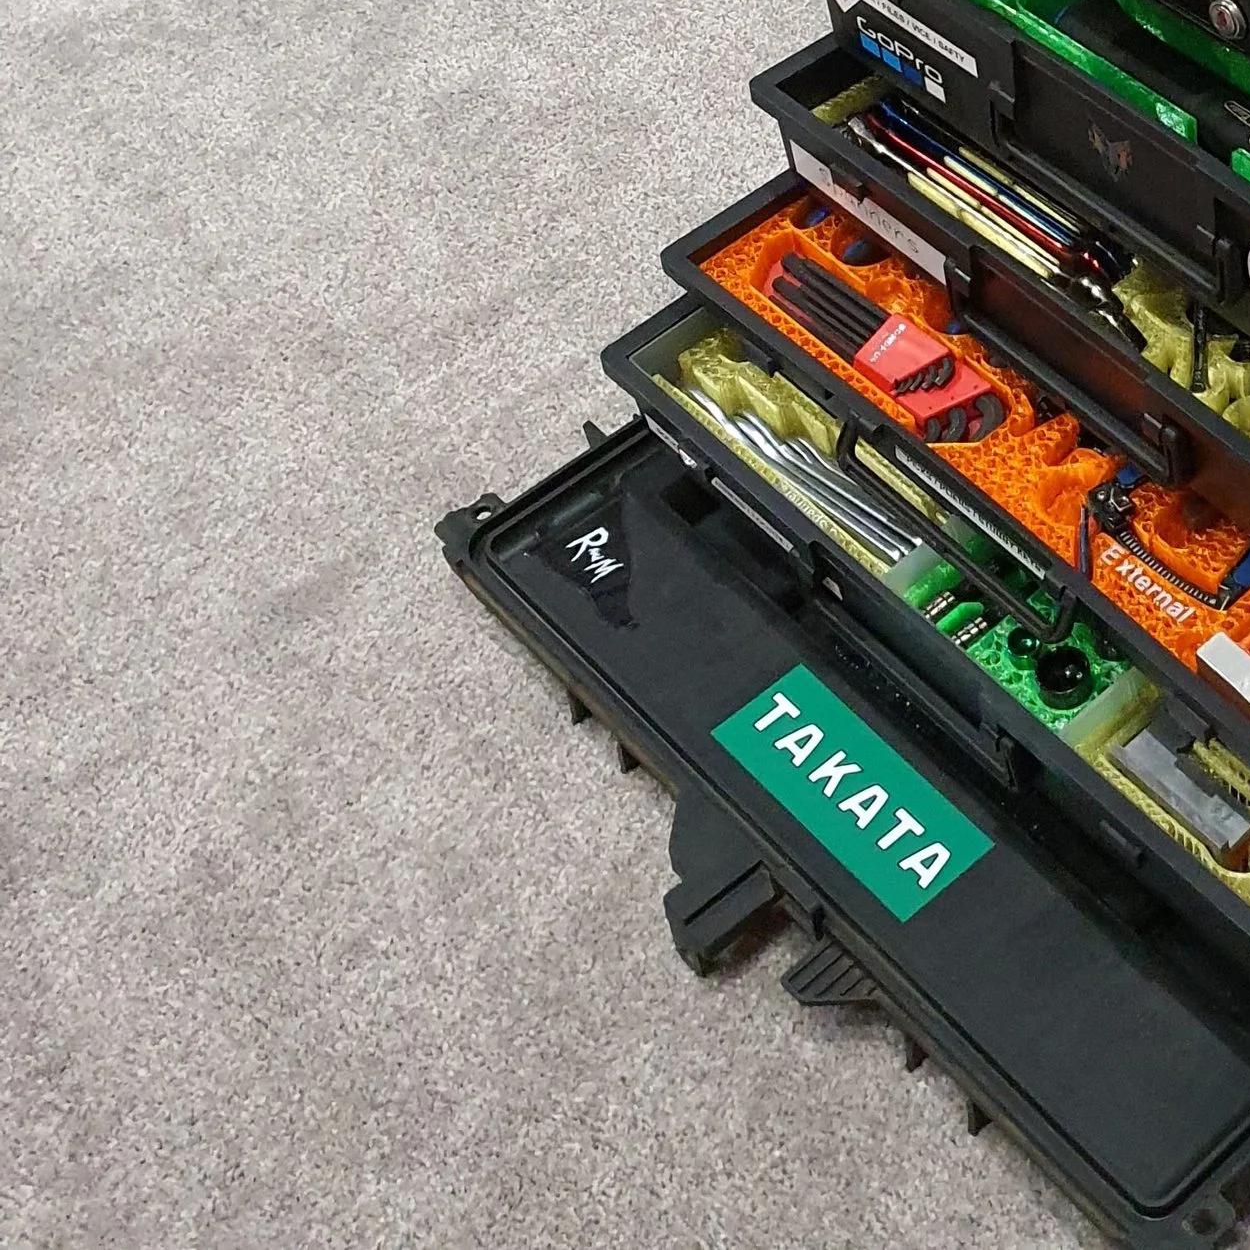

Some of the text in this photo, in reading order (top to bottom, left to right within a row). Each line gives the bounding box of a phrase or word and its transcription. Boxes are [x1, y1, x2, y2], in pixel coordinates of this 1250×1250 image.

[856, 16, 943, 84] GoPro
[1098, 545, 1196, 624] External
[753, 691, 952, 890] TAKATA
